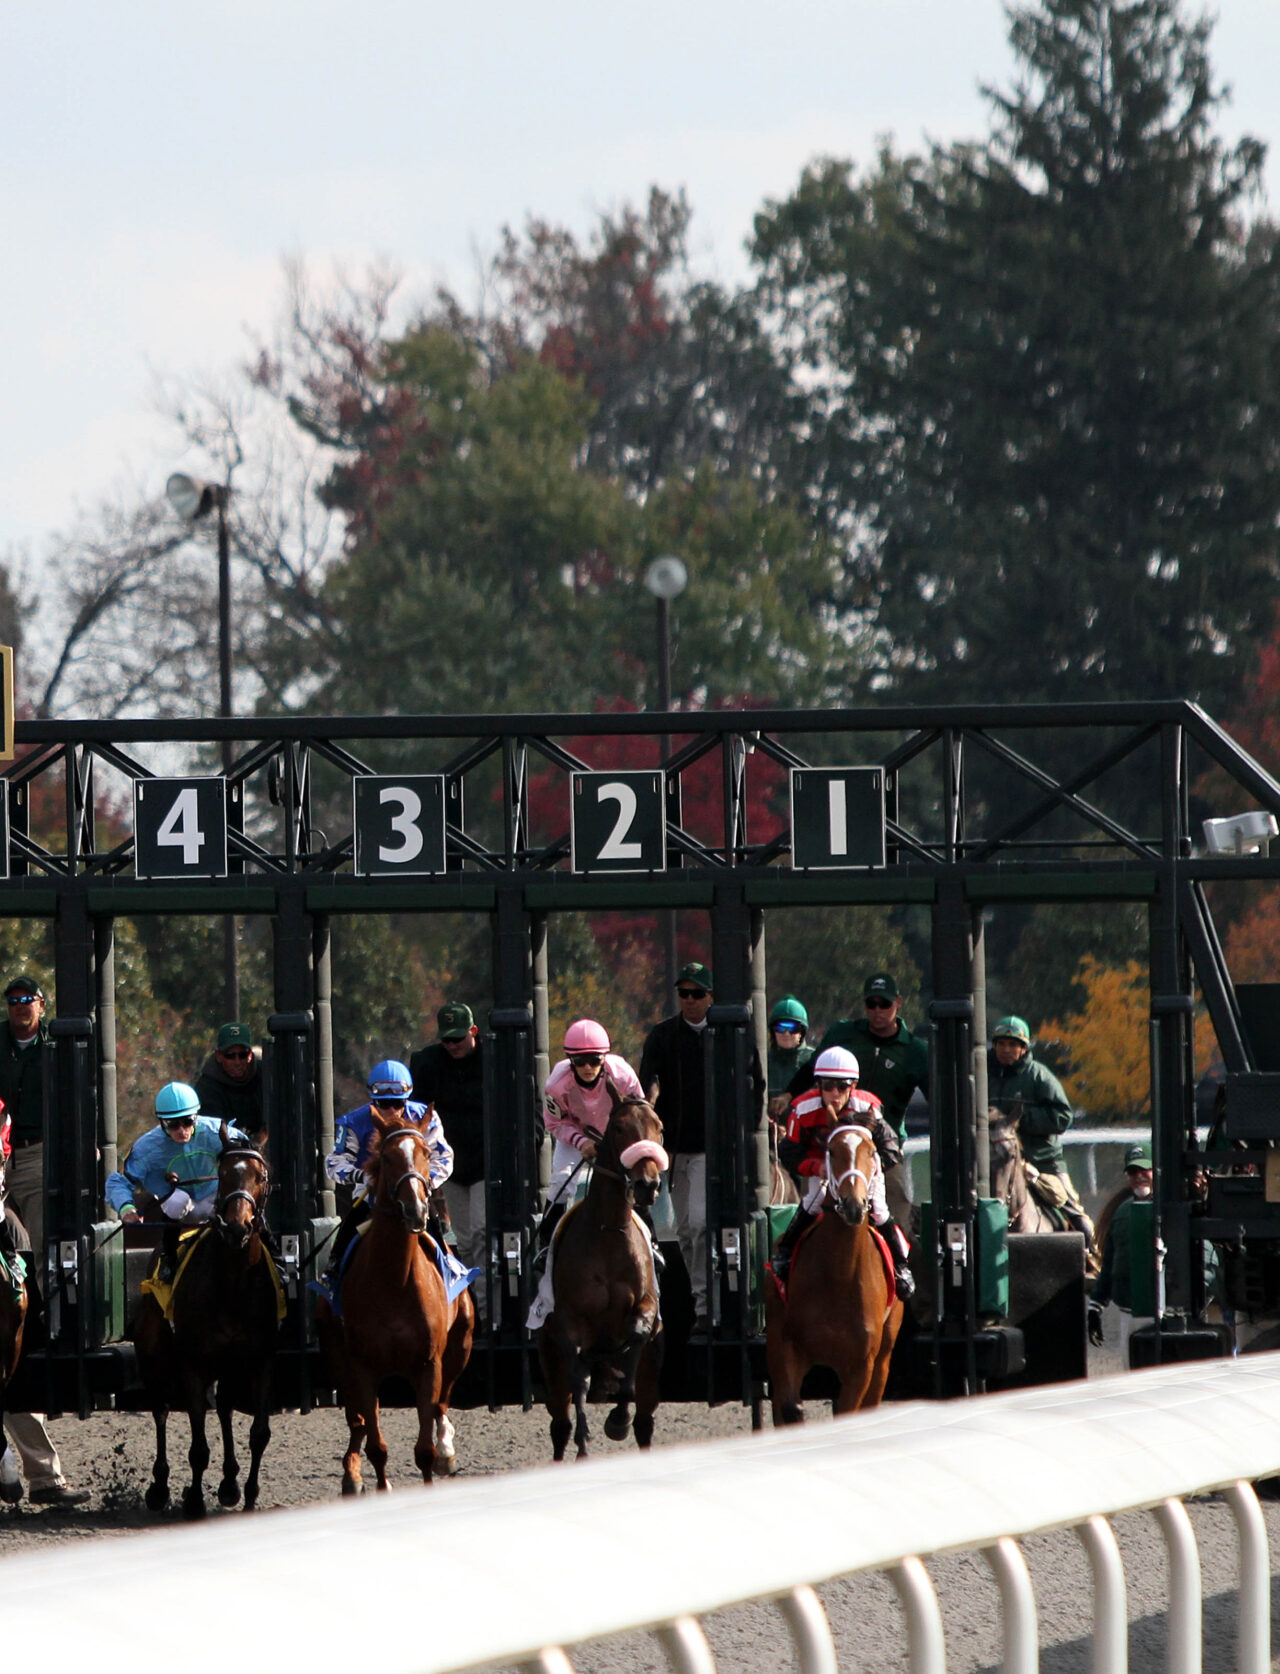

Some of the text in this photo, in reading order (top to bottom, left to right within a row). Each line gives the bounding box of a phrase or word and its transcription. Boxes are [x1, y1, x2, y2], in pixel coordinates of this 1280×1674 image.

[156, 788, 205, 865] 4
[378, 786, 424, 863] 3
[596, 782, 642, 860] 2
[828, 779, 847, 856] 1
